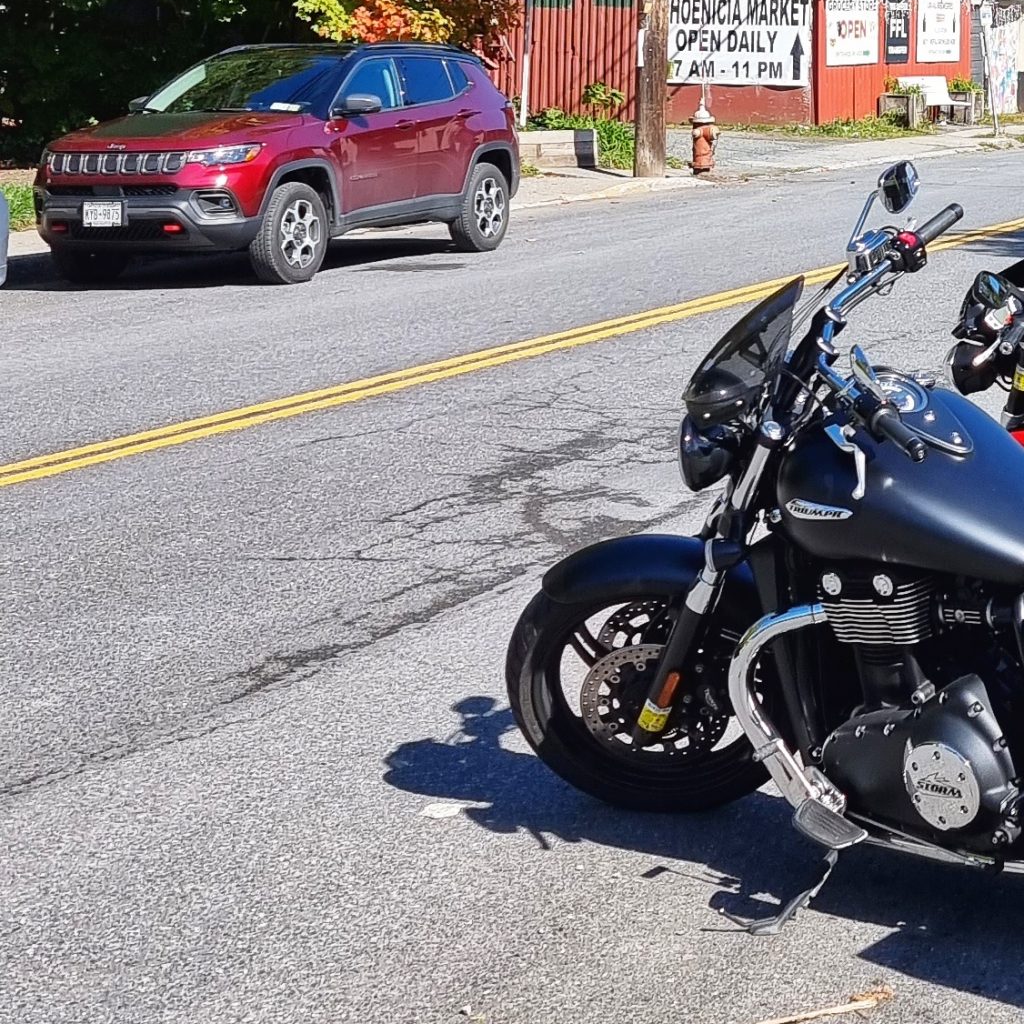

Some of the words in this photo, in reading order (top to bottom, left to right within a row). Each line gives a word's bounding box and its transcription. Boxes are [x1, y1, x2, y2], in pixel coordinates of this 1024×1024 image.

[858, 0, 877, 11] STORE
[840, 19, 867, 39] OPEN
[675, 29, 721, 52] OPEN
[727, 30, 778, 53] DAILY
[673, 59, 683, 76] 7
[688, 59, 715, 78] AM
[731, 60, 750, 78] 11
[757, 61, 783, 79] PM
[789, 504, 844, 519] TRIUMPH
[916, 780, 963, 799] STORM
